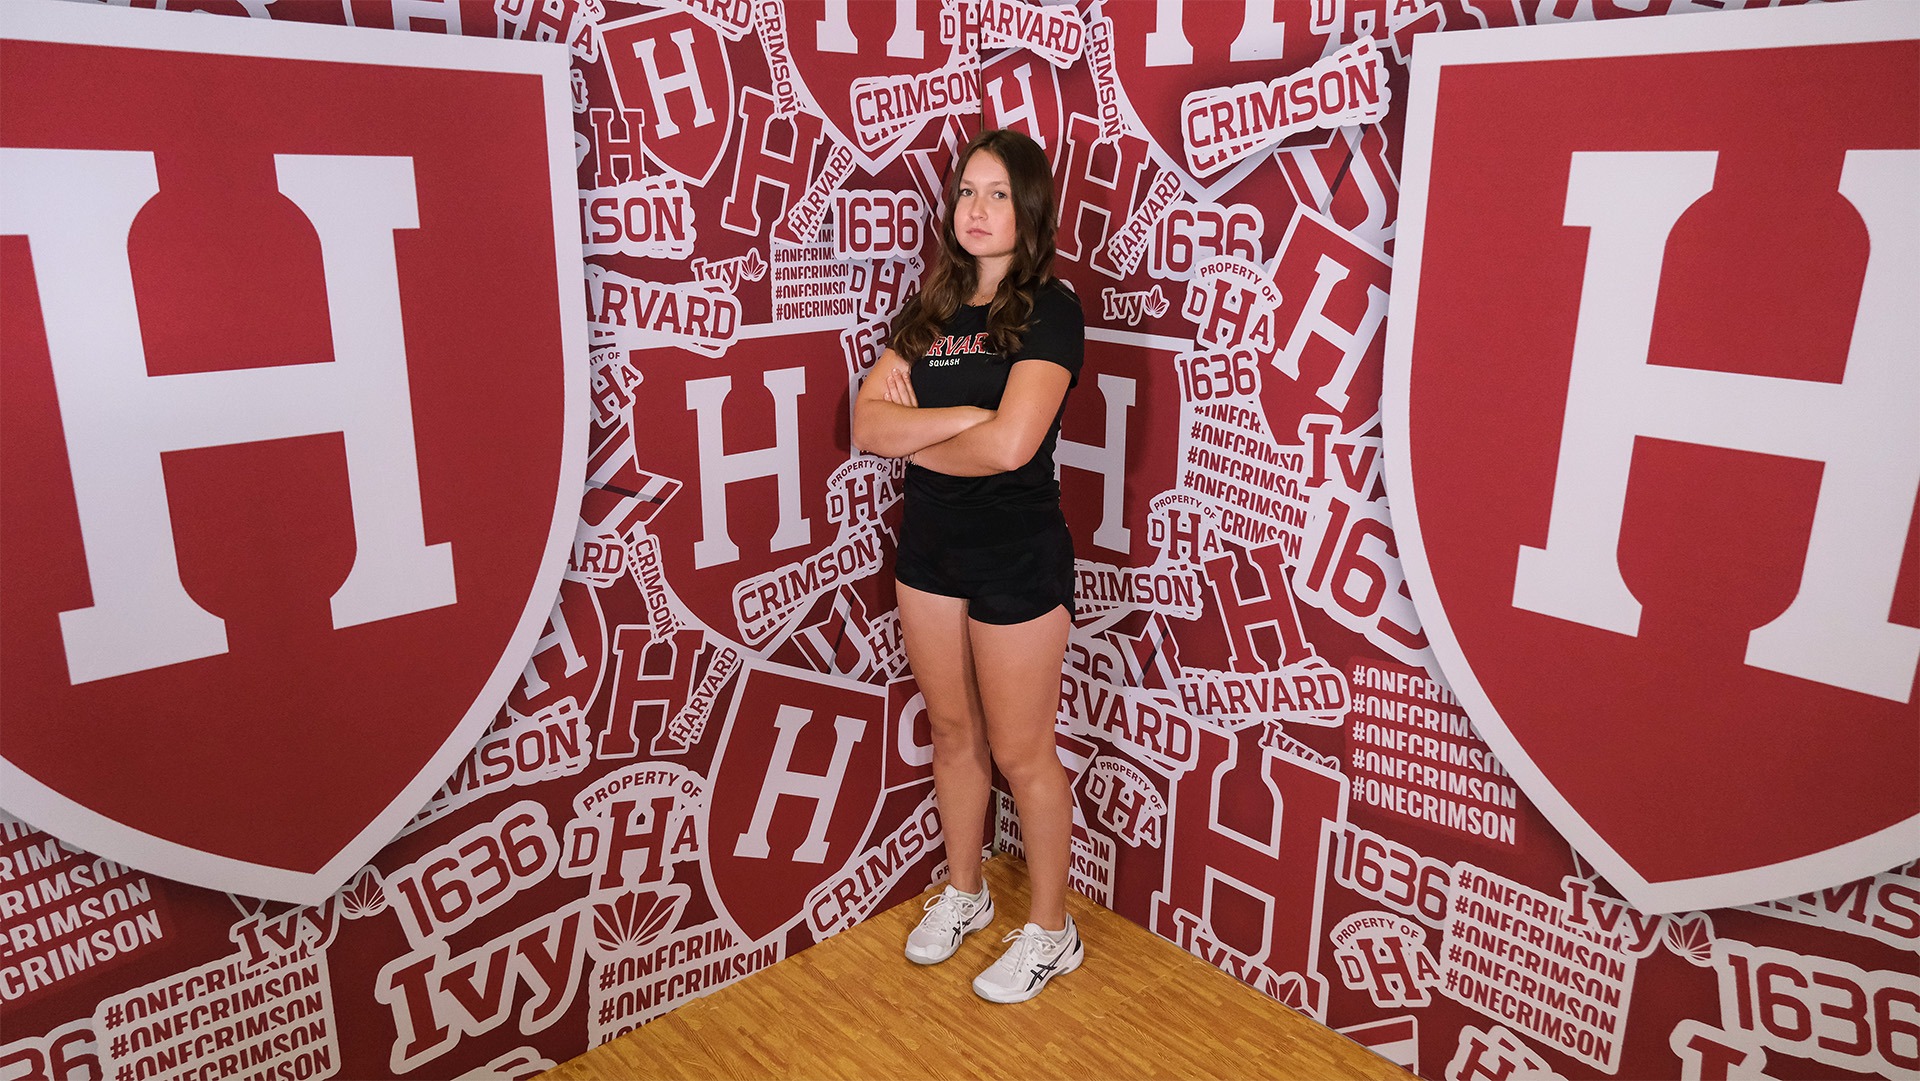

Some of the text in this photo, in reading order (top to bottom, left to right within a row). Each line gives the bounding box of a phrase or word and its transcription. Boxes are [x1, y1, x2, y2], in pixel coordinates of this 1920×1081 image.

[762, 1, 796, 114] CRIMSON
[981, 3, 1082, 61] ARVARD
[632, 28, 715, 139] H
[856, 68, 980, 126] CRIMSON
[1091, 21, 1121, 140] CRIMSON
[1187, 59, 1380, 148] CRIMSON
[592, 110, 646, 186] H
[791, 145, 853, 237] HARVARD
[836, 197, 919, 253] 1636
[1110, 171, 1181, 267] HARVARD
[1154, 209, 1256, 273] 1636
[585, 279, 736, 340] RVARD
[776, 298, 853, 320] #ONECRIMSON
[1104, 291, 1142, 323] Ivy
[1200, 262, 1276, 303] PROPERTY OF
[929, 358, 960, 367] SQUASH
[1179, 351, 1256, 402] 1636
[1271, 254, 1393, 413] H
[686, 366, 811, 570] H
[831, 460, 876, 487] PROPERTY
[877, 461, 888, 473] OF
[1305, 423, 1384, 493] Iv
[1154, 495, 1217, 519] PROPERTY OF
[635, 539, 675, 638] CRIMSON
[739, 535, 877, 623] CRIMSON
[1205, 543, 1315, 671] H
[672, 646, 737, 742] HARVARD
[1058, 673, 1192, 762] RVARD
[1178, 676, 1344, 715] HARVARD
[583, 769, 702, 811] PROPERTY OF
[733, 704, 867, 865] H
[1101, 762, 1163, 810] PROPERTY OF
[1353, 749, 1517, 810] #ONECRIMSON
[1353, 776, 1516, 846] #ONECRIMSON
[397, 814, 547, 938] 1636
[812, 806, 942, 932] CRIMSO
[1340, 829, 1450, 921] 1636
[237, 895, 335, 968] Ivy
[1336, 918, 1419, 945] PROPERTY OF
[1455, 895, 1625, 982] #ONECRIMSON
[1567, 881, 1662, 952] Ivy
[391, 911, 580, 1060] Ivy
[1449, 944, 1616, 1034] #ONECRIMSON
[1452, 920, 1621, 1008] #ONECRIMSON
[110, 964, 320, 1060] #ONECRIMSON
[1445, 968, 1612, 1066] #ONECRIMSON
[1728, 953, 1920, 1071] 1636
